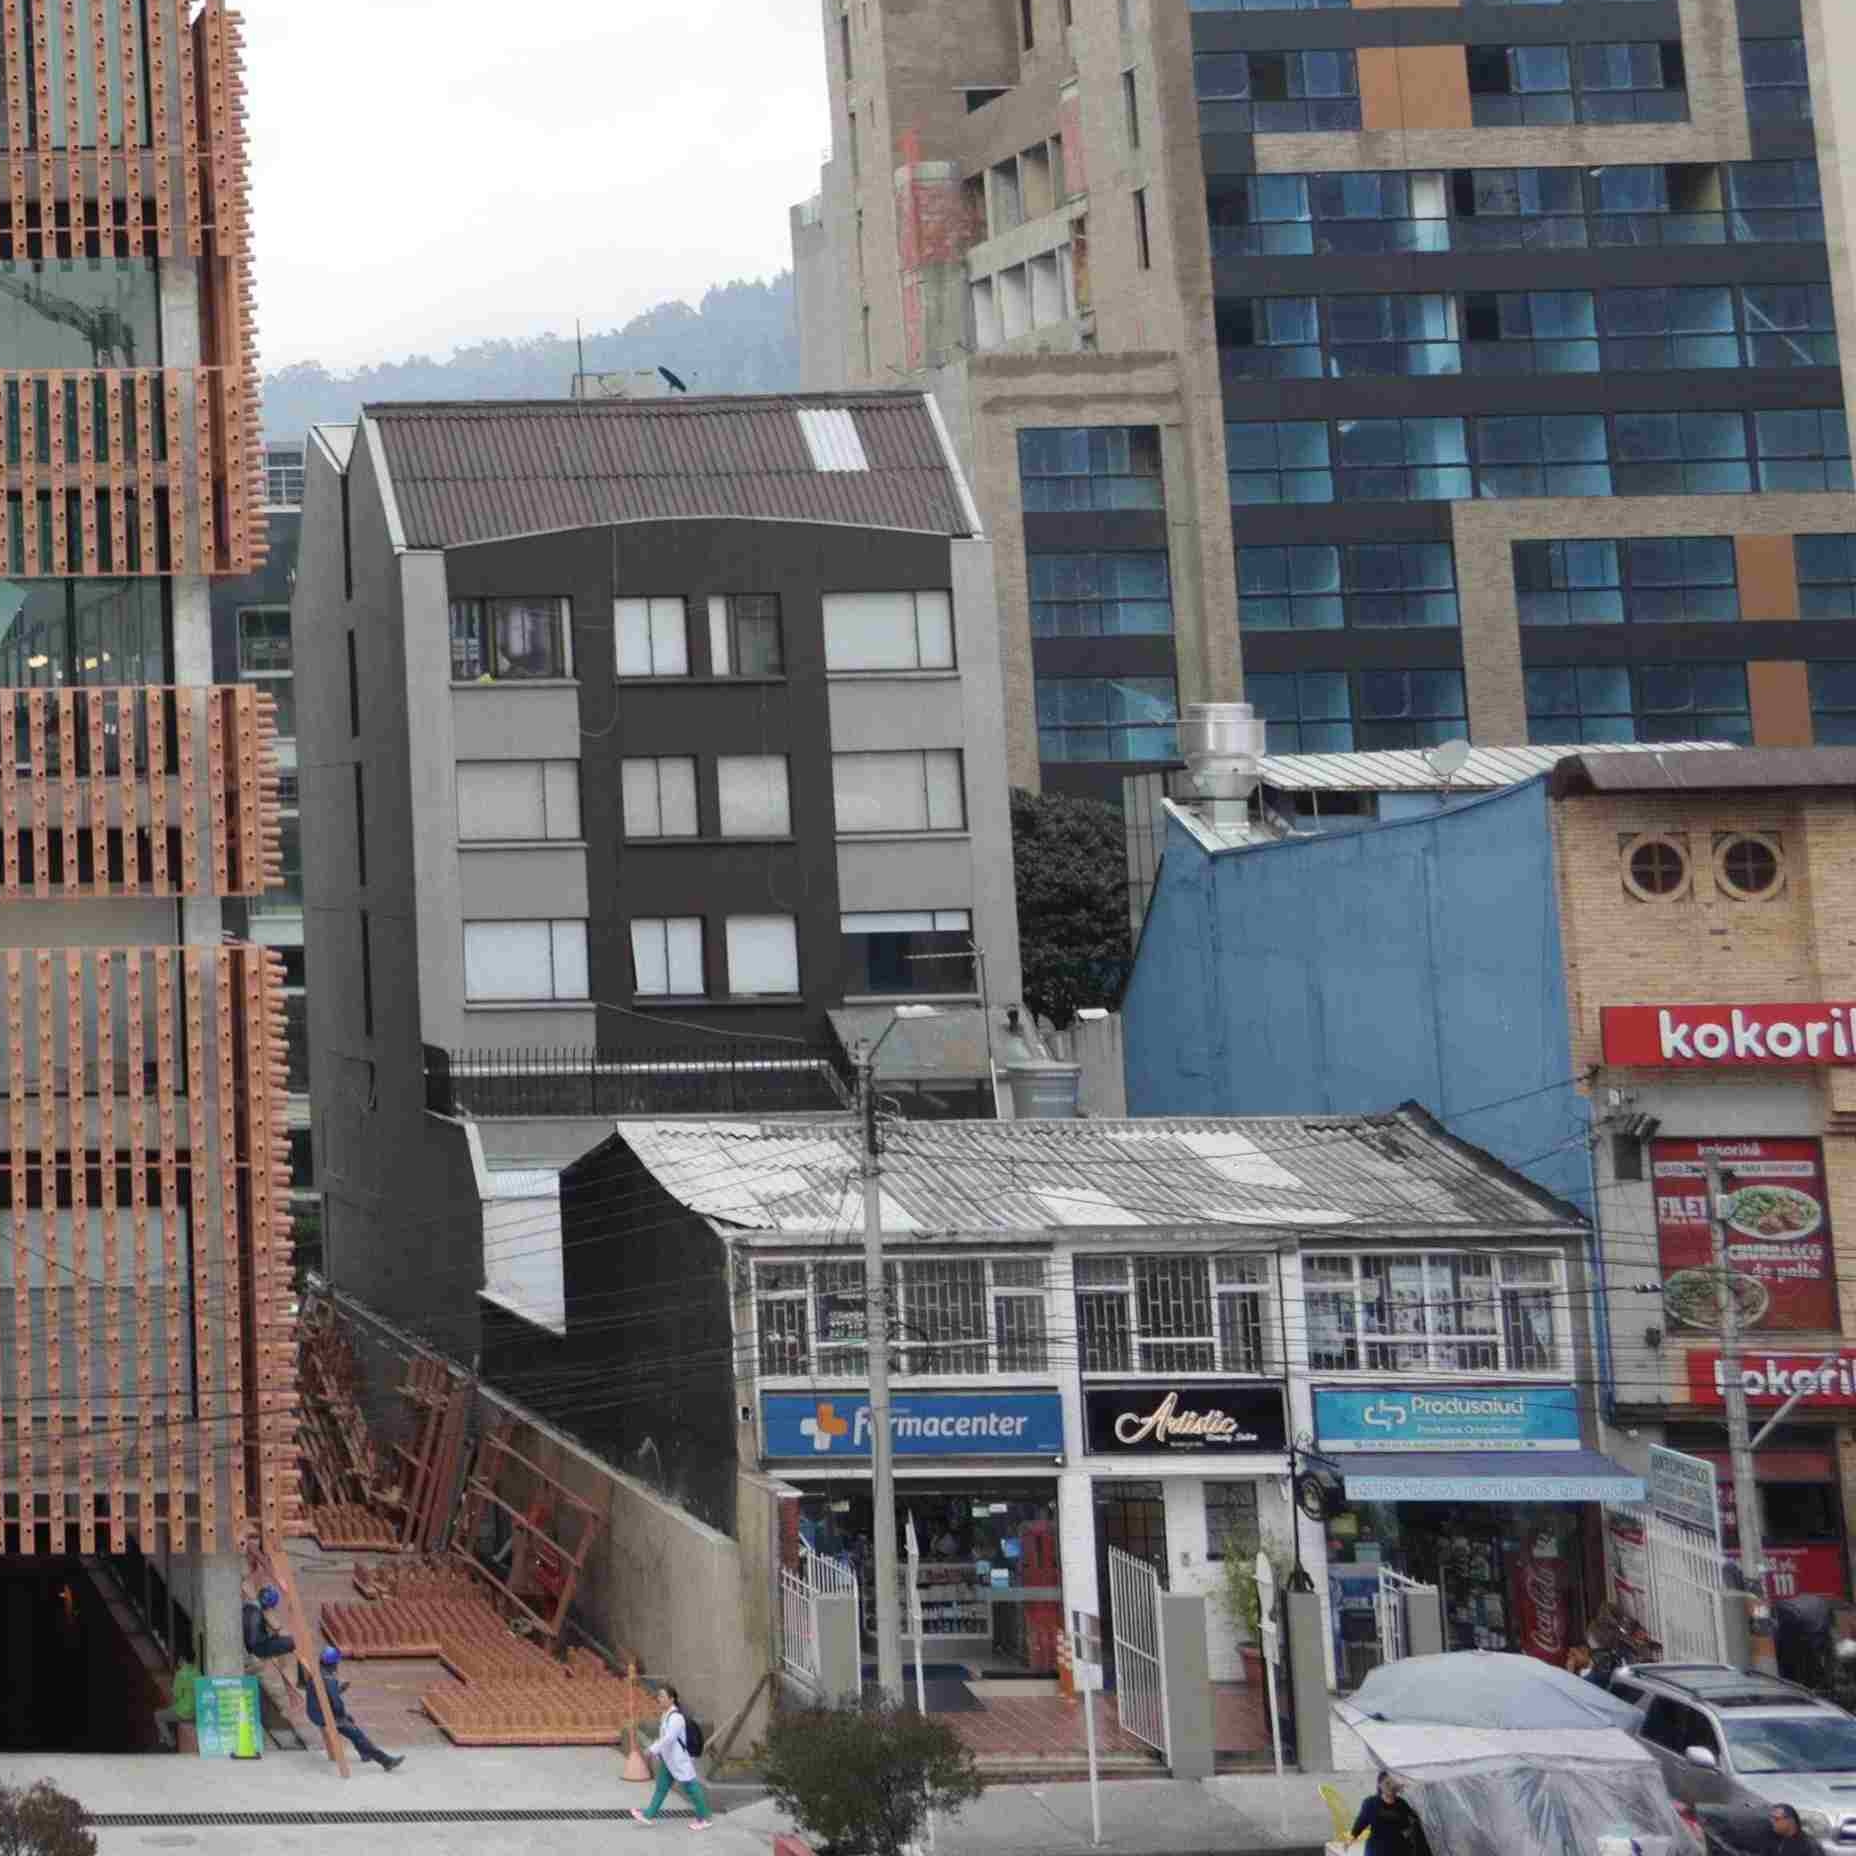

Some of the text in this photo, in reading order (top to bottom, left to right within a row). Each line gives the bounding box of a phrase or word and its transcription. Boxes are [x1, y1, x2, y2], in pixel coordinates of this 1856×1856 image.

[1715, 1359, 1856, 1395] okori
[1115, 1392, 1238, 1443] Artistic
[1411, 1396, 1524, 1416] Produsalud
